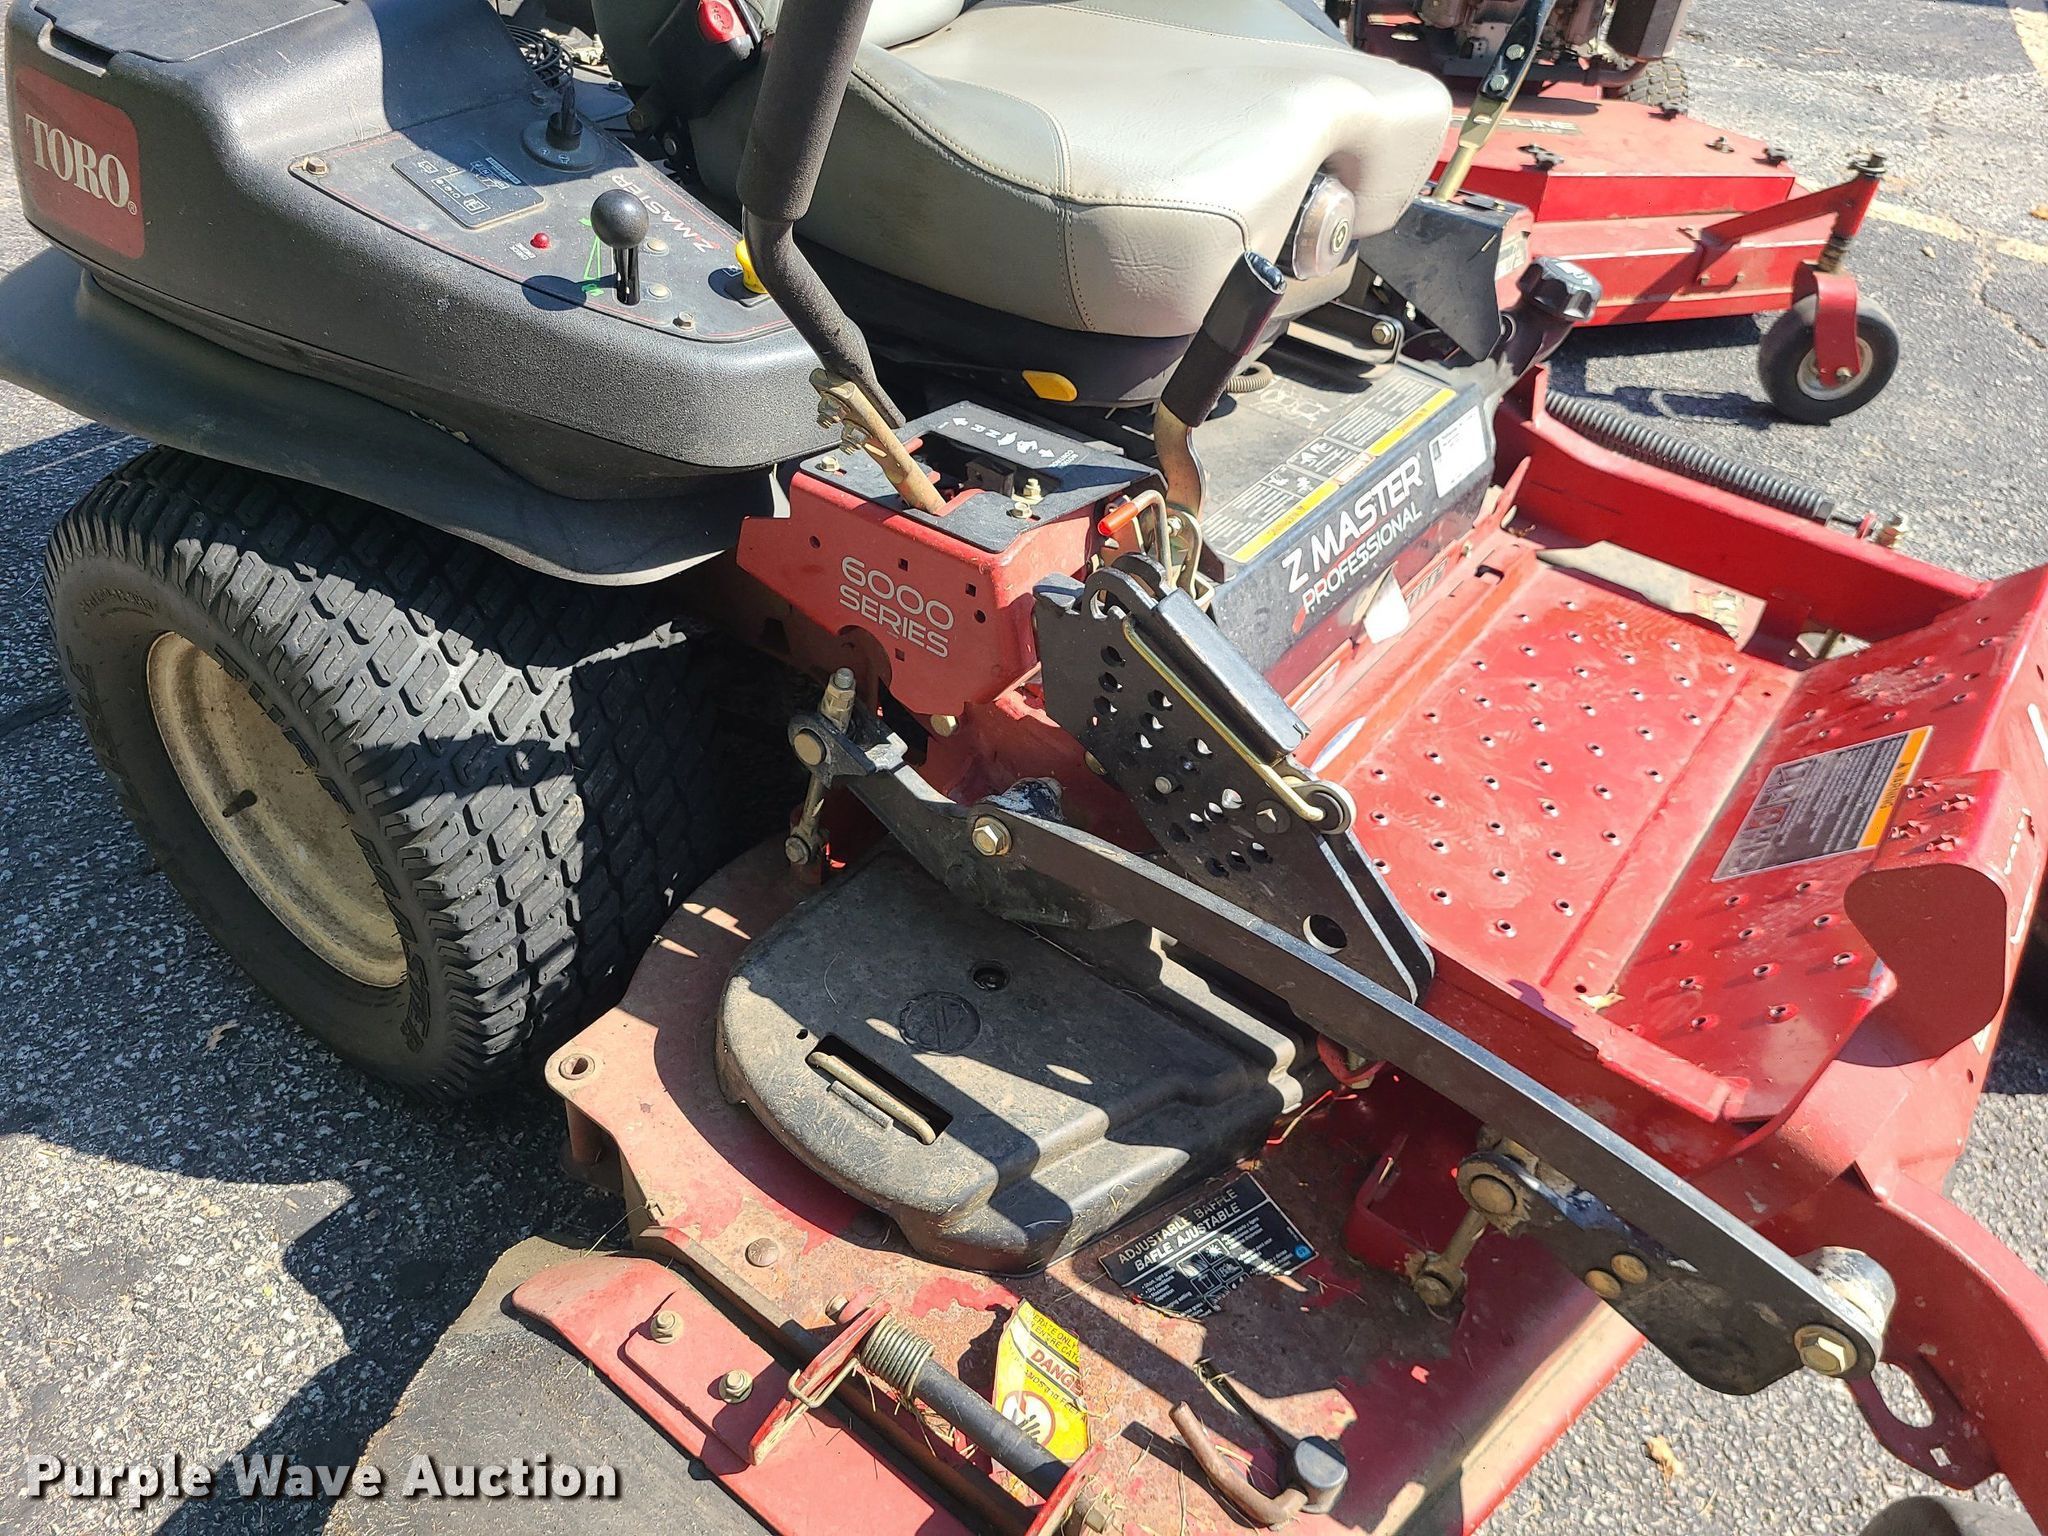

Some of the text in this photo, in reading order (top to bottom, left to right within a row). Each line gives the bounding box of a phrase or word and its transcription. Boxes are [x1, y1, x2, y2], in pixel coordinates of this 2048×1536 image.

[1282, 547, 1309, 593] Z
[1310, 456, 1423, 572] MASTER
[1302, 501, 1423, 613] PROFESSIONAL
[840, 584, 949, 658] SERIES
[842, 556, 954, 630] 6000
[1118, 1216, 1192, 1264] ADJUSTABLE
[1193, 1189, 1238, 1218] BAFFLE
[1134, 1242, 1173, 1272] BAFLE
[1177, 1202, 1241, 1249] AJUSTABLE
[1031, 1349, 1084, 1397] DANGE
